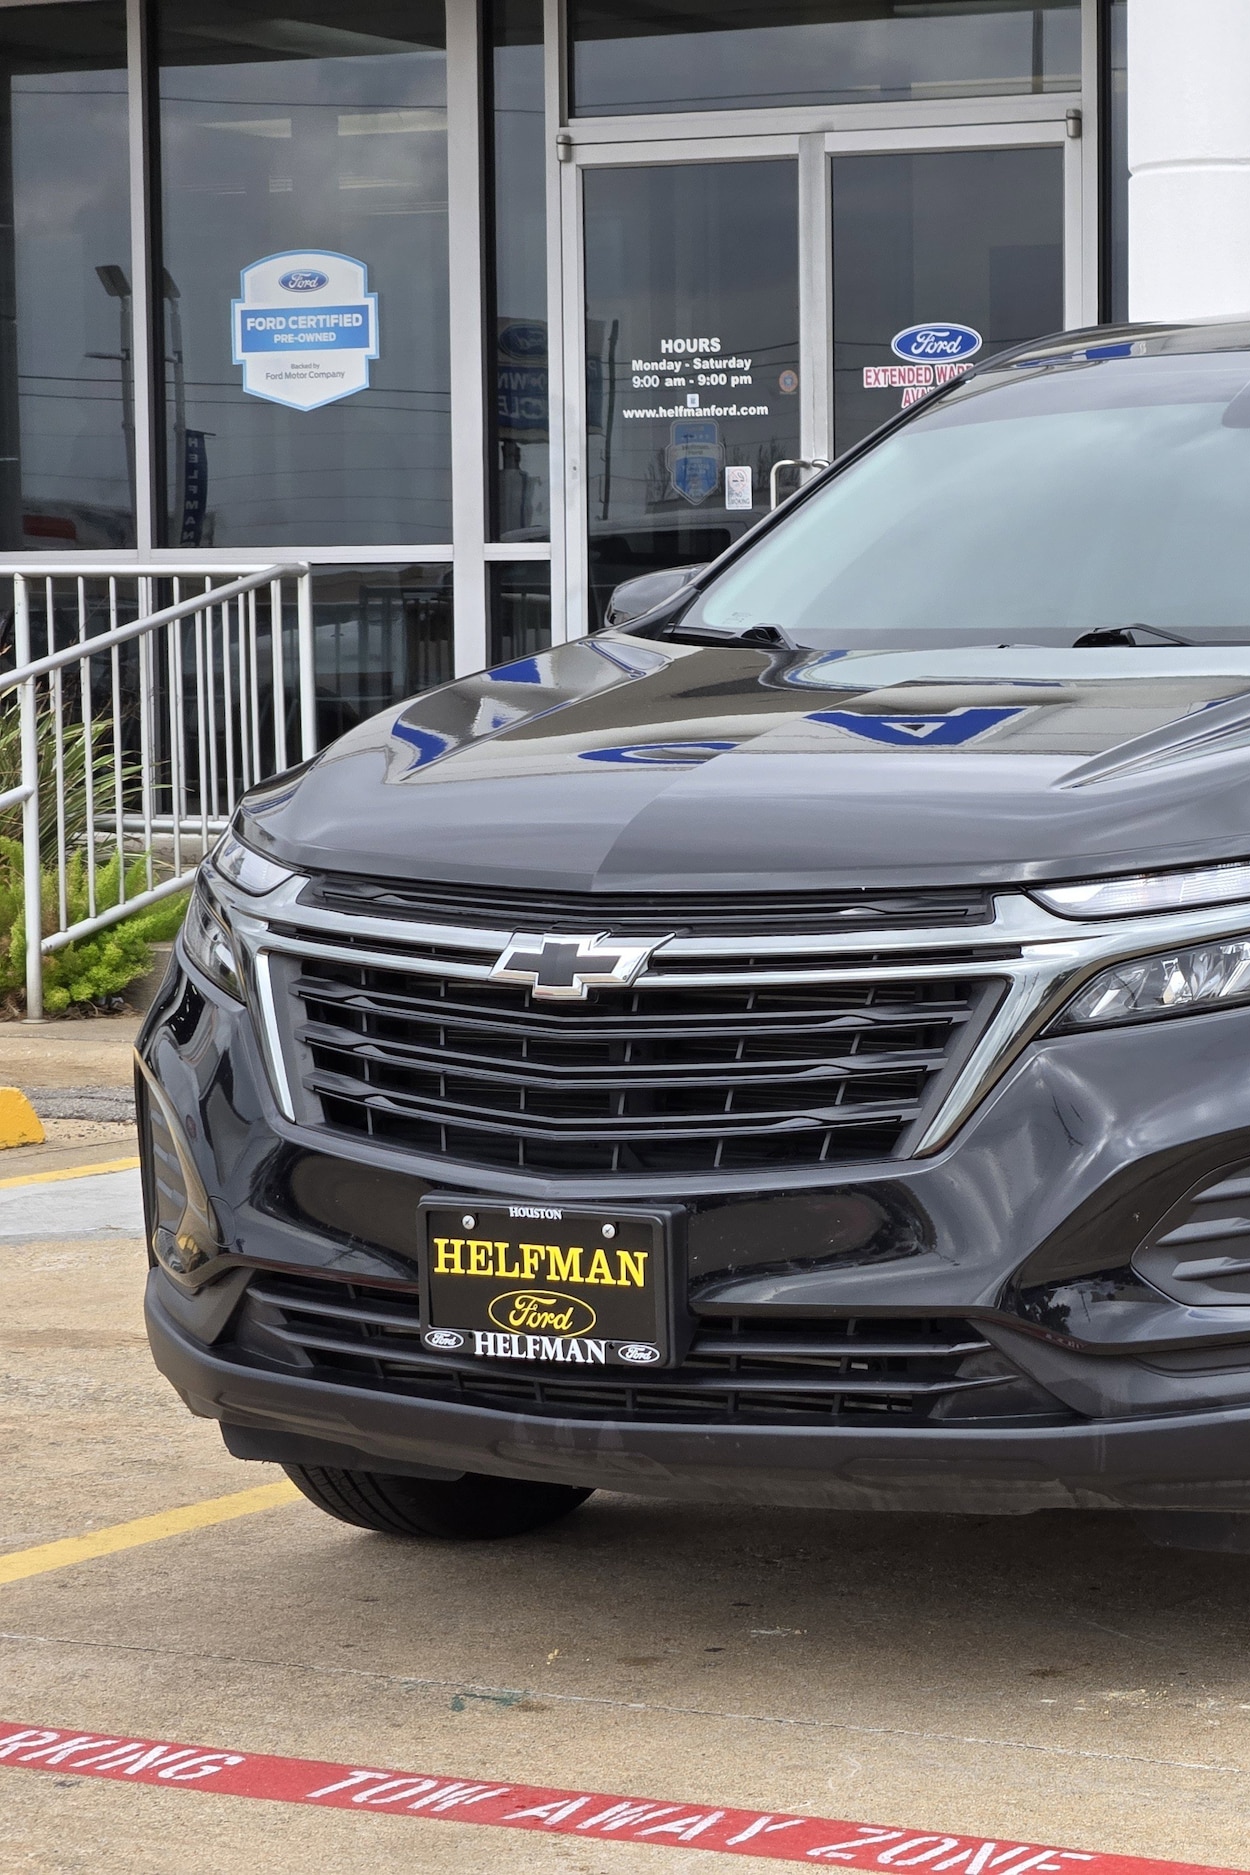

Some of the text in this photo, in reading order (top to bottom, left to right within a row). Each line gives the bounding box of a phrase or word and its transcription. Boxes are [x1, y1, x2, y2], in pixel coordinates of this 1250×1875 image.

[289, 272, 319, 289] Ford
[246, 313, 363, 331] FORD CERTIFIED
[273, 332, 337, 344] PRE-OWNED
[660, 337, 721, 354] HOURS
[911, 330, 962, 354] Ford
[290, 362, 320, 371] Backed by
[631, 359, 682, 373] Monday
[692, 356, 752, 371] Saturday
[265, 370, 346, 380] Ford Motor Company
[632, 375, 660, 388] 9:00
[664, 376, 686, 387] am
[697, 373, 727, 387] 9:00
[730, 374, 753, 387] pm
[863, 365, 933, 388] EXTENDED
[622, 404, 769, 419] www.helfmanford.com
[508, 1207, 563, 1220] HOUSTON
[433, 1237, 649, 1287] HELFMAN
[508, 1295, 574, 1331] Ford
[431, 1333, 458, 1347] Ford
[474, 1331, 607, 1365] HELFMAN
[625, 1347, 652, 1361] Ford
[306, 1770, 510, 1813] TOW
[503, 1796, 806, 1846] AWAY
